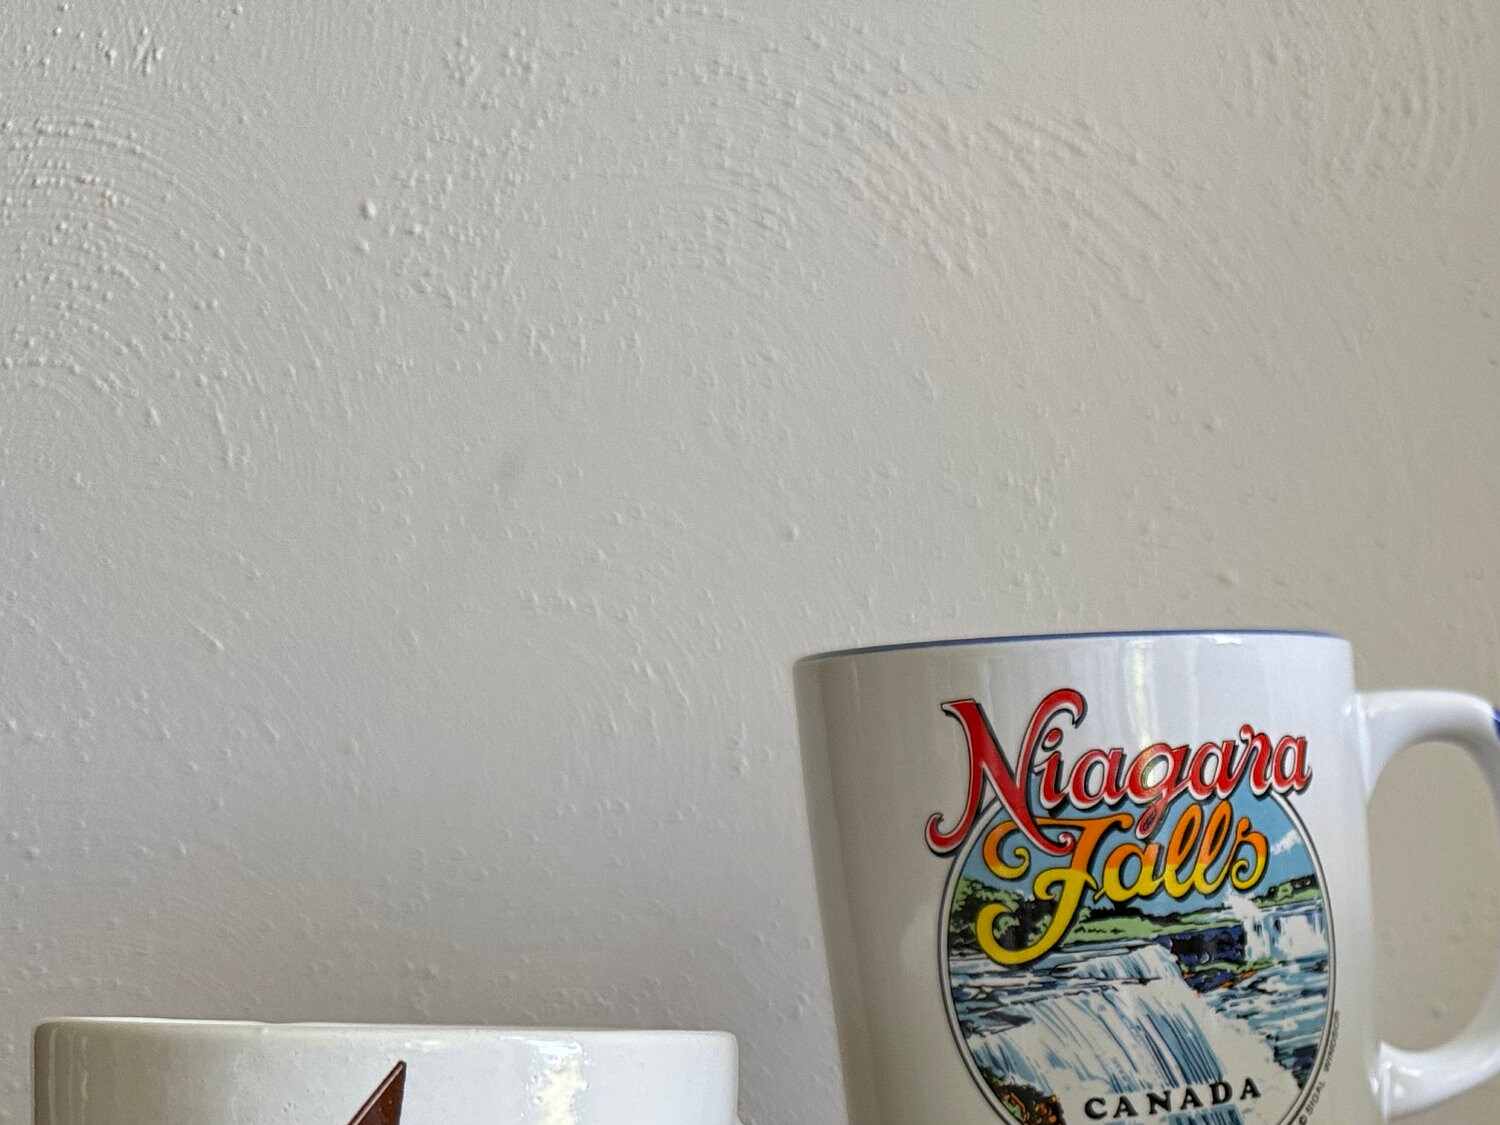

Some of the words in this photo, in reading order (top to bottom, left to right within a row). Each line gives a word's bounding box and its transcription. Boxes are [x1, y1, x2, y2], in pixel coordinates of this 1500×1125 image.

[925, 688, 1313, 860] Niagara
[976, 800, 1271, 966] Falls
[1083, 1076, 1262, 1121] CANADA
